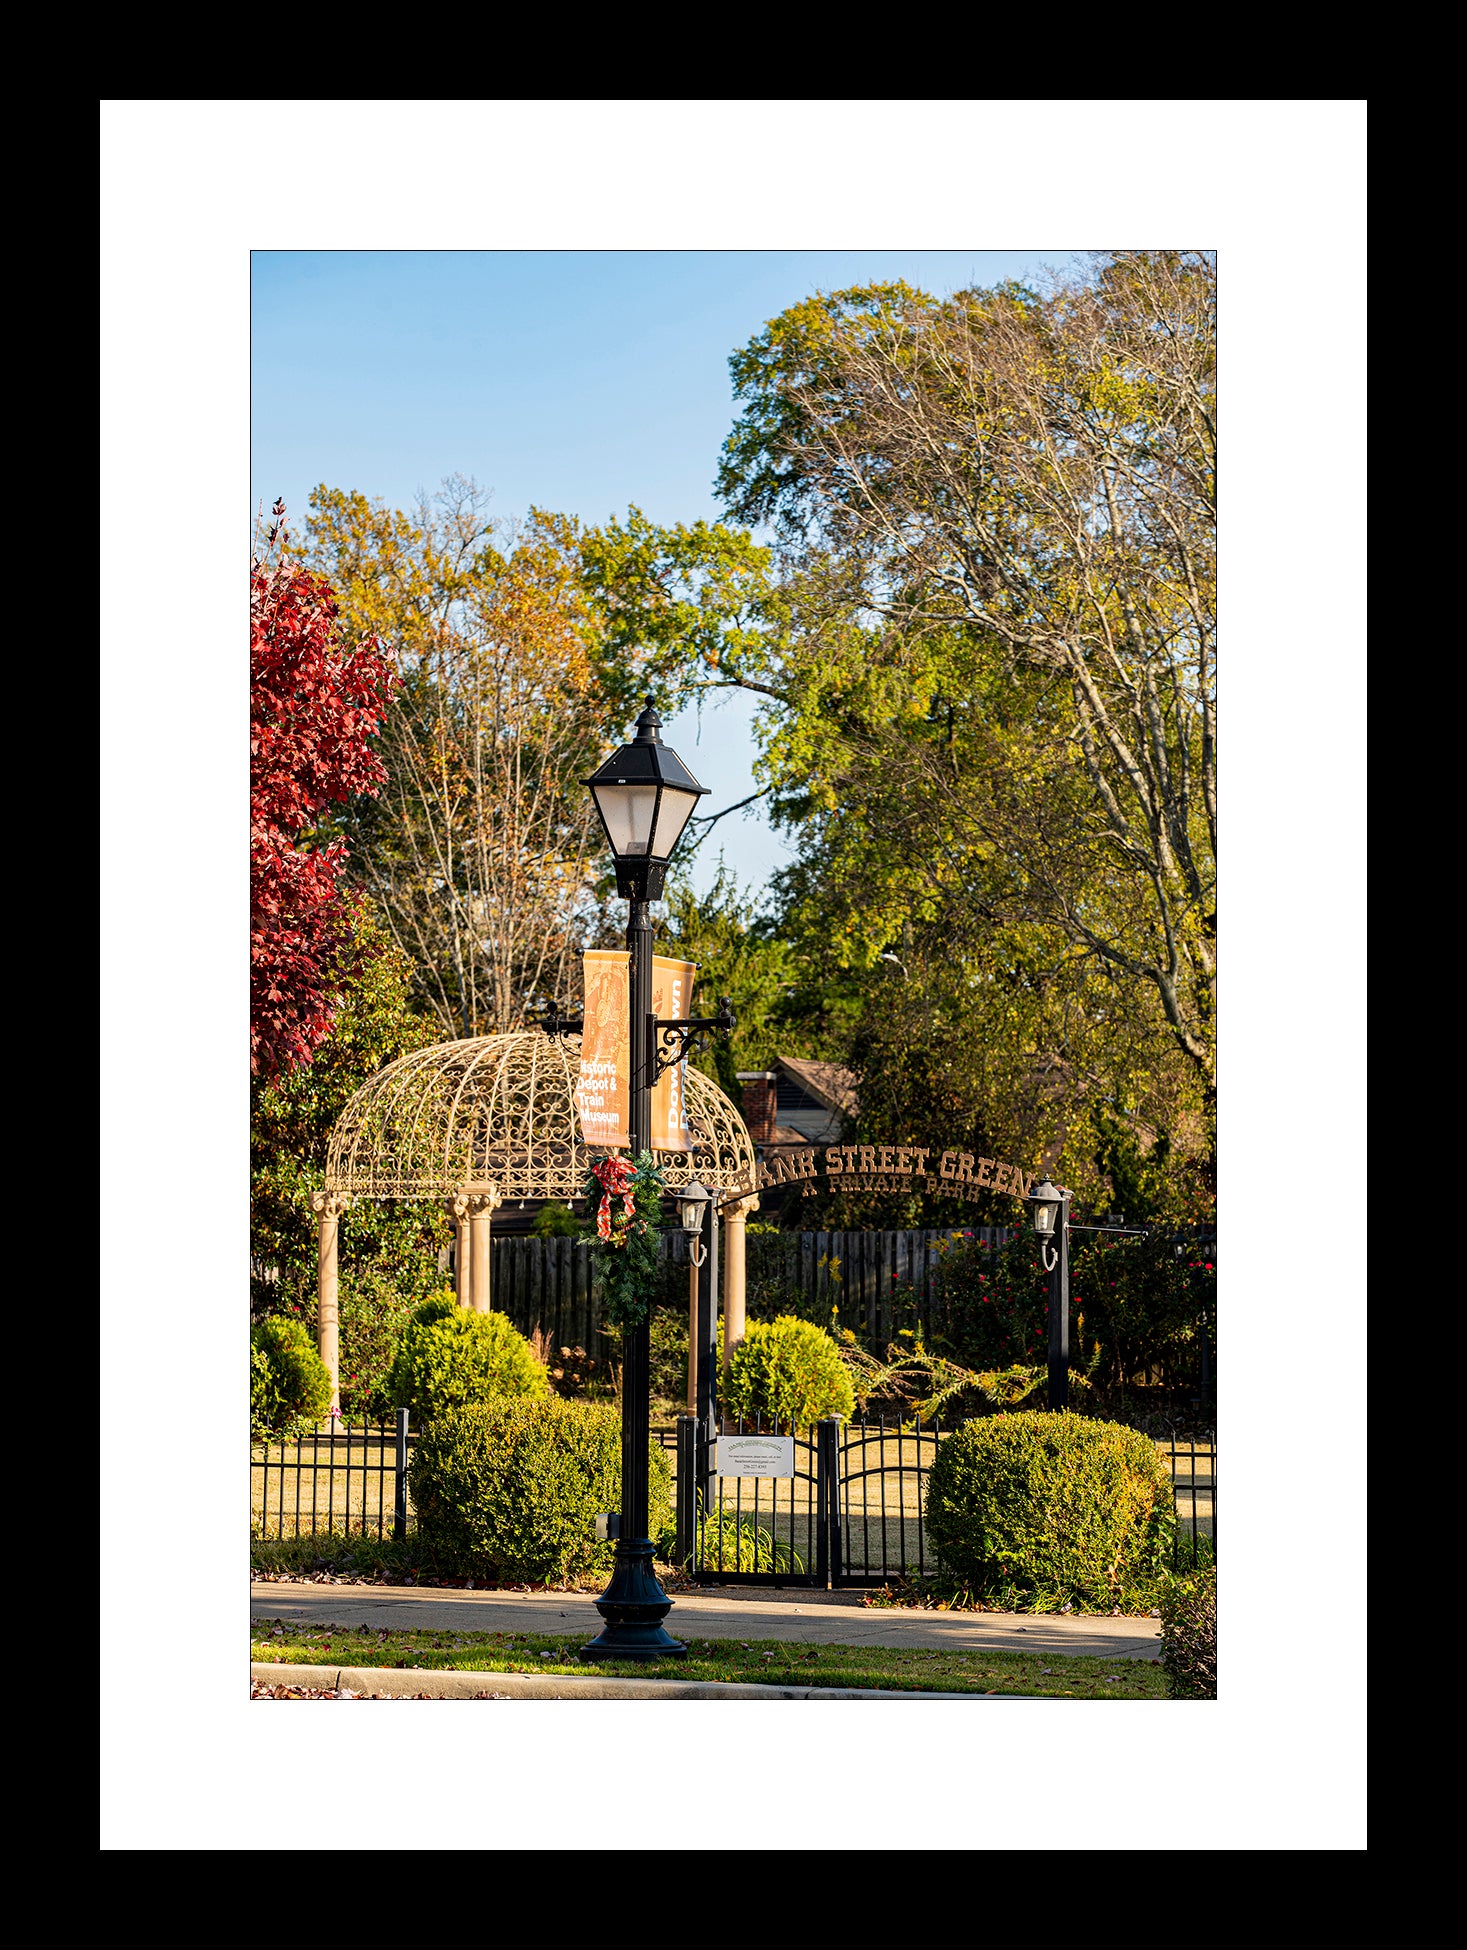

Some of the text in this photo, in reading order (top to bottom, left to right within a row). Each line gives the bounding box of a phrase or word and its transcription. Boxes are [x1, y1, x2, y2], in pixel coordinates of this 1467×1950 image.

[668, 979, 683, 1129] Dowwn
[576, 1076, 617, 1092] Depot &
[577, 1092, 605, 1107] Train
[580, 1108, 620, 1123] Museum
[732, 1144, 1036, 1200] BANK STREET GREEN
[802, 1174, 980, 1203] A PRIVATE PARK
